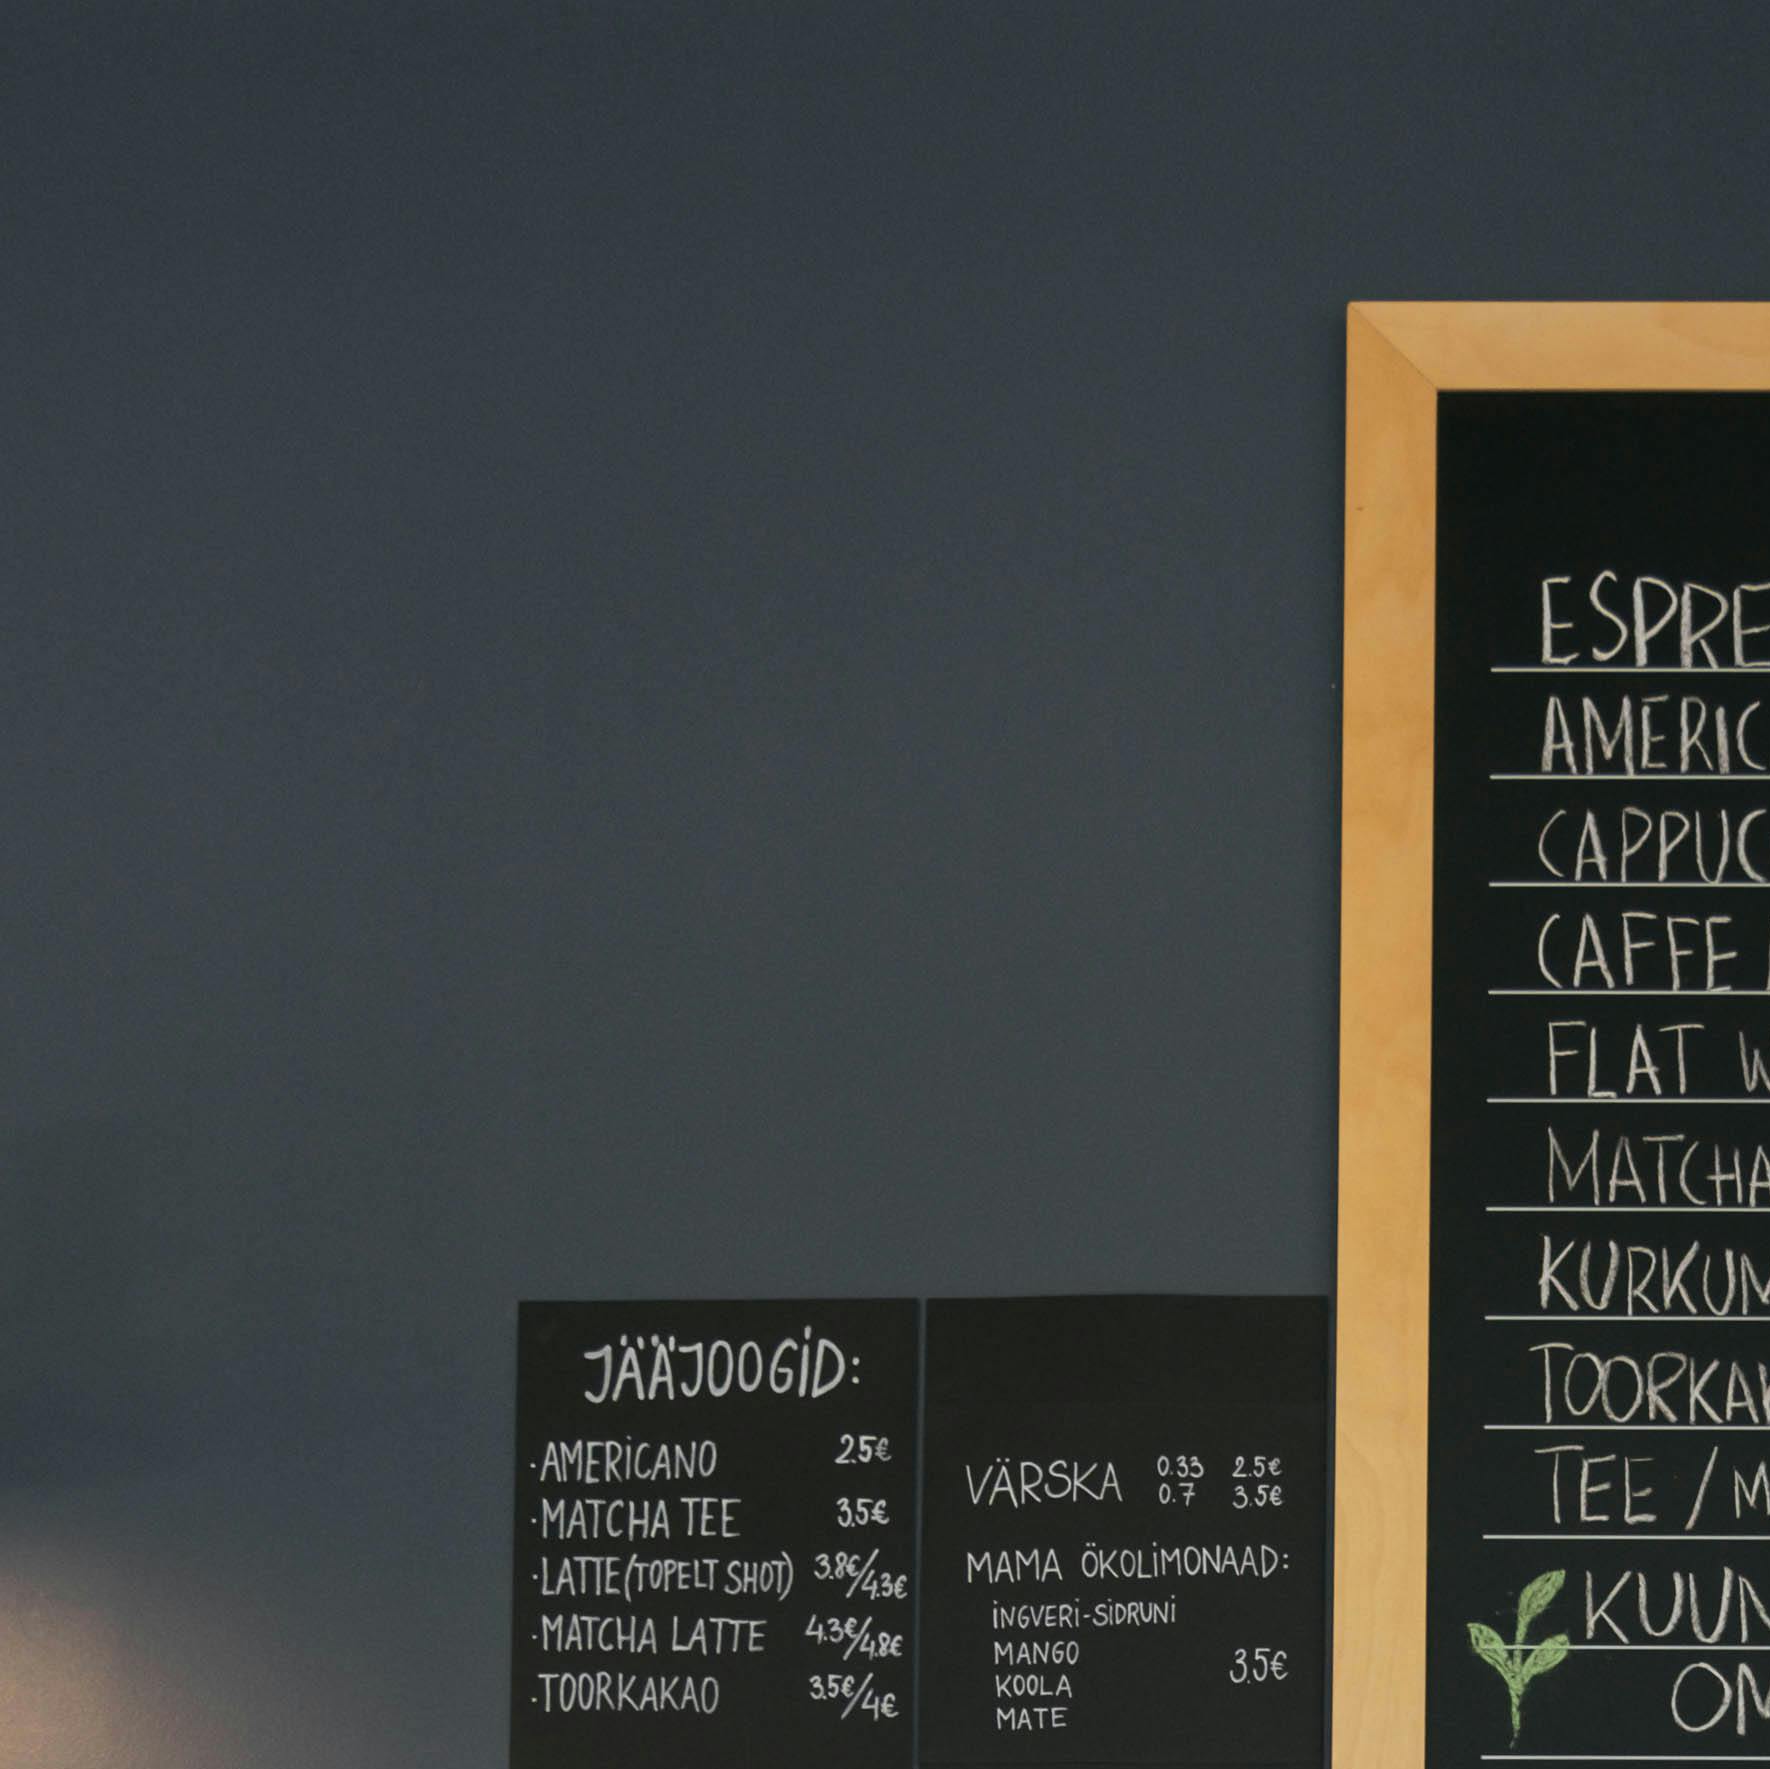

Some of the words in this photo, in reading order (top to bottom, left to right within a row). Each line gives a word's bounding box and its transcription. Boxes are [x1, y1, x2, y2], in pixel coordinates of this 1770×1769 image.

[1536, 910, 1739, 989] CAFFE
[1547, 1020, 1705, 1099] FLAT
[540, 1434, 717, 1484] AMERICANO
[835, 1434, 892, 1464] 2.5€
[965, 1458, 1123, 1508] VÄRSKA
[1157, 1455, 1204, 1479] 0.33
[1232, 1456, 1282, 1478] 2.5€
[1158, 1483, 1196, 1506] 0.7
[1232, 1485, 1283, 1509] 3.5€
[1535, 1444, 1656, 1525] TEE
[542, 1499, 670, 1539] MATCHA
[681, 1498, 741, 1537] TEE
[837, 1499, 890, 1527] 3.5€
[725, 1551, 794, 1601] SHOT)
[967, 1548, 1063, 1584] MAMA
[542, 1614, 657, 1654] MATCHA
[672, 1616, 766, 1653] LATTE
[994, 1641, 1080, 1666] MANGO
[995, 1674, 1073, 1699] KOOLA
[1230, 1648, 1288, 1684] 3.5€
[538, 1671, 719, 1714] TOORKAKAO
[996, 1707, 1068, 1730] MATE
